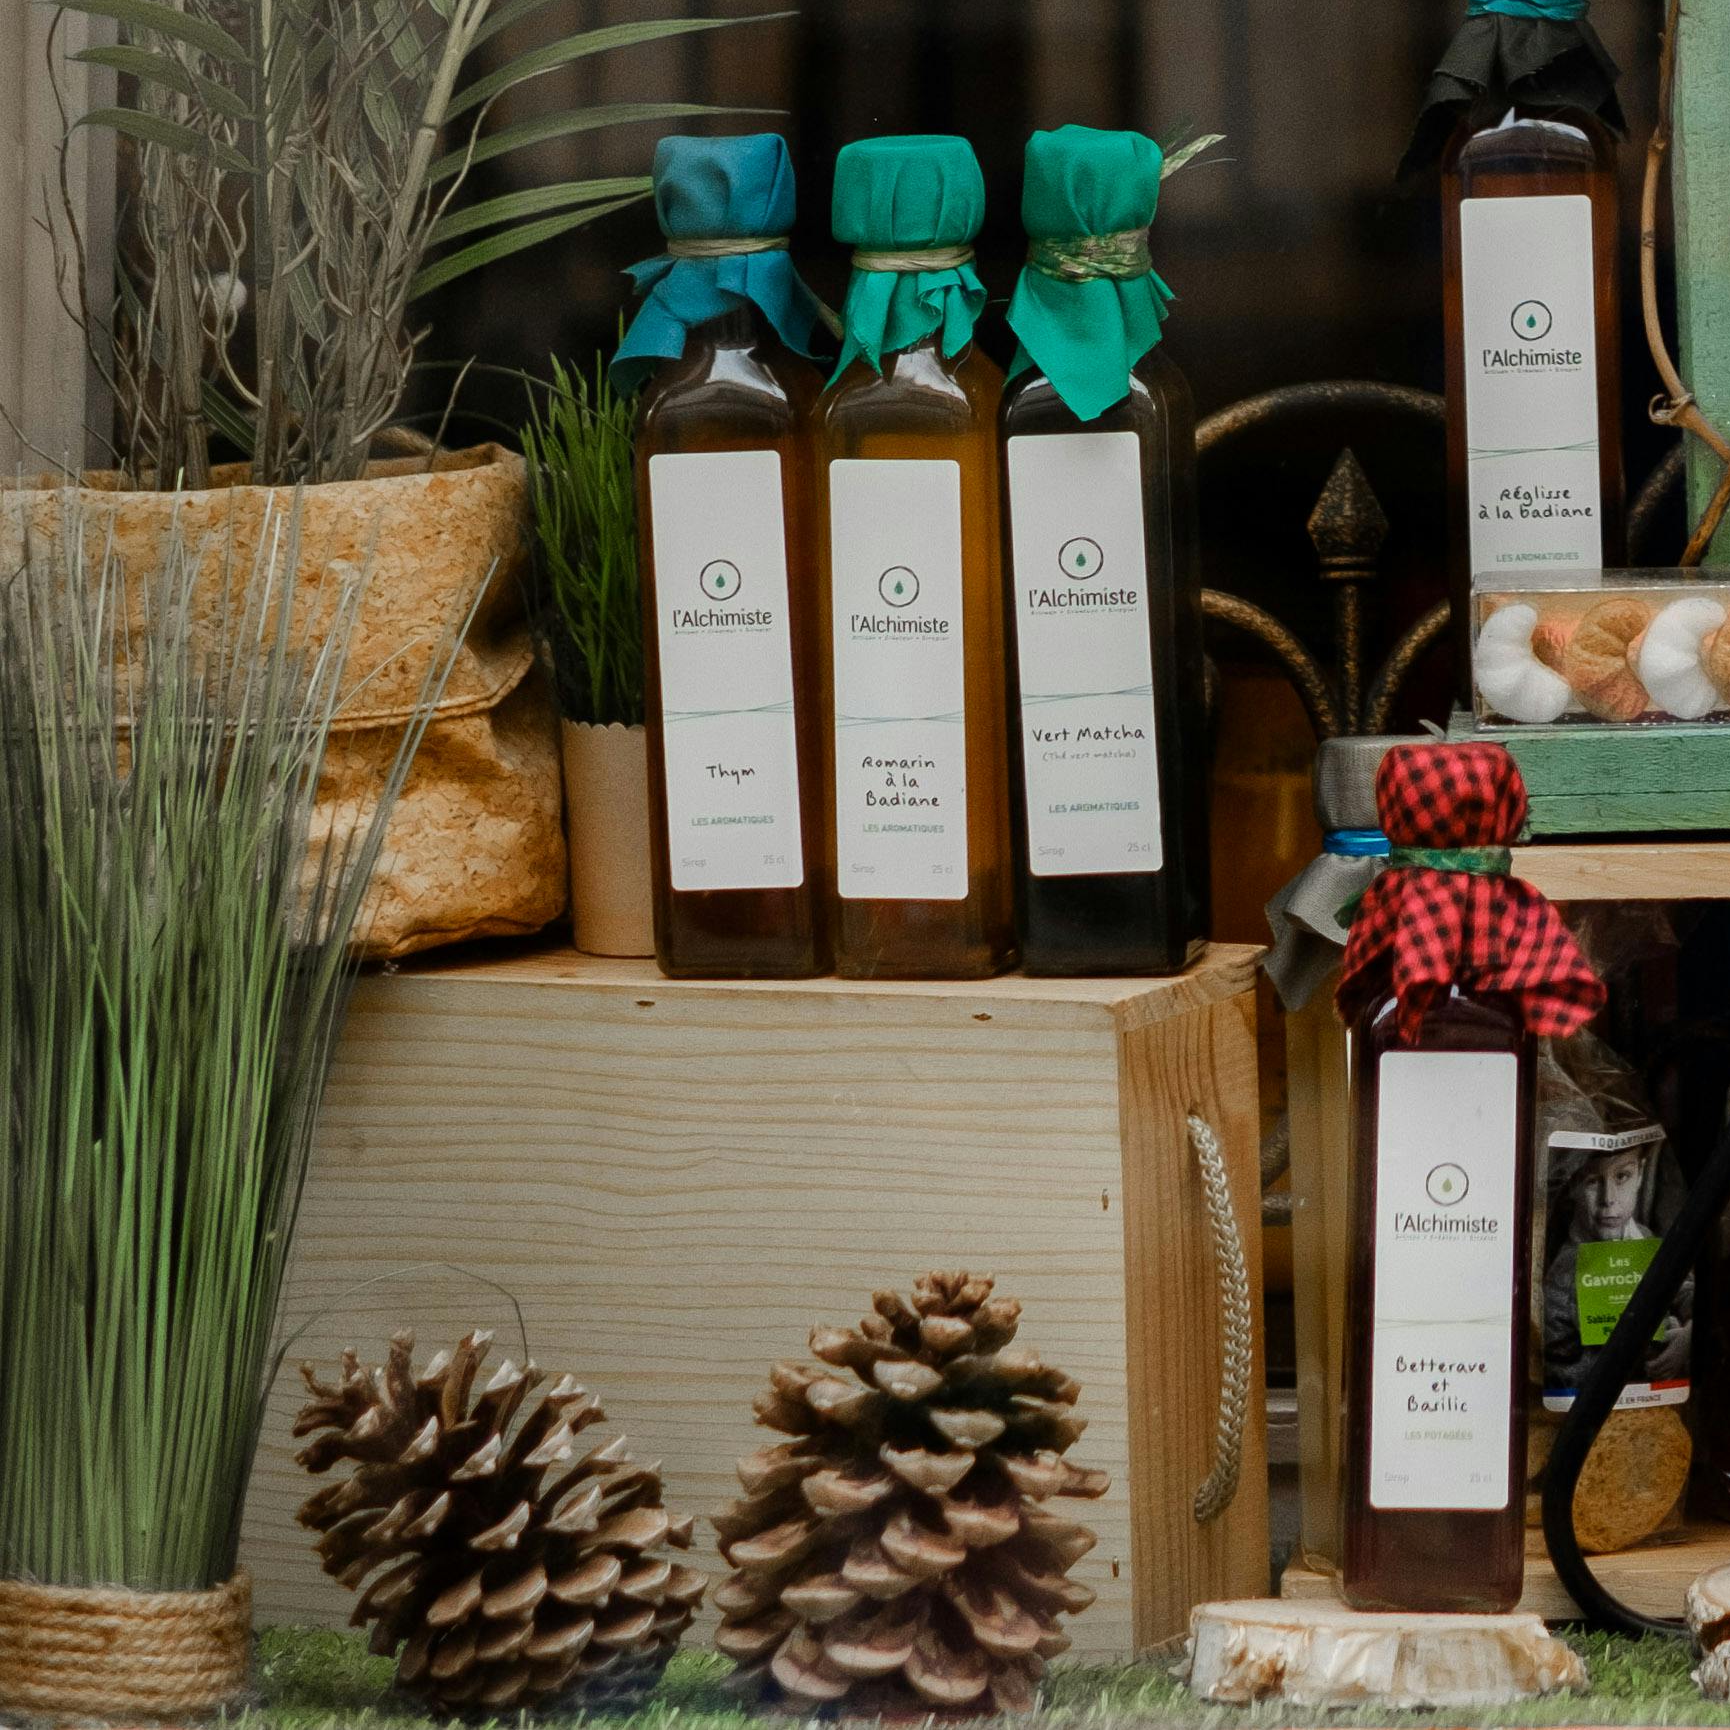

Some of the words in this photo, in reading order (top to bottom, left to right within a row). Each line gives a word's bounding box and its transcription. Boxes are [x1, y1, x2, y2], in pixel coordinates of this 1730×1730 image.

[1482, 347, 1583, 368] l'Alchimiste
[1499, 483, 1572, 508] Réglisse
[1478, 503, 1490, 521] à
[1495, 502, 1514, 520] la
[1519, 501, 1594, 520] badiane
[1497, 553, 1514, 564] LES
[1515, 550, 1580, 563] AROMATIQUES
[1028, 587, 1138, 609] l'Alchimiste
[673, 608, 773, 629] l'Alchimiste
[851, 614, 950, 635] l'Alchimiste
[1032, 728, 1071, 743] Vert
[1076, 724, 1146, 742] Matcha
[861, 753, 936, 769] Romarin
[705, 762, 756, 786] Thym
[885, 772, 897, 788] à
[902, 772, 920, 788] la
[865, 790, 941, 808] Badiane
[1048, 803, 1067, 814] LES
[1069, 800, 1140, 814] AROMATIQUES
[691, 816, 709, 827] LES
[710, 814, 775, 827] AROMATIQUES
[862, 823, 880, 834] LES
[881, 823, 945, 834] AROMATIQUES
[1394, 1212, 1499, 1234] l'Alchimiste
[1395, 1355, 1488, 1374] Betterave
[1430, 1377, 1450, 1393] et
[1407, 1395, 1469, 1414] Basilic
